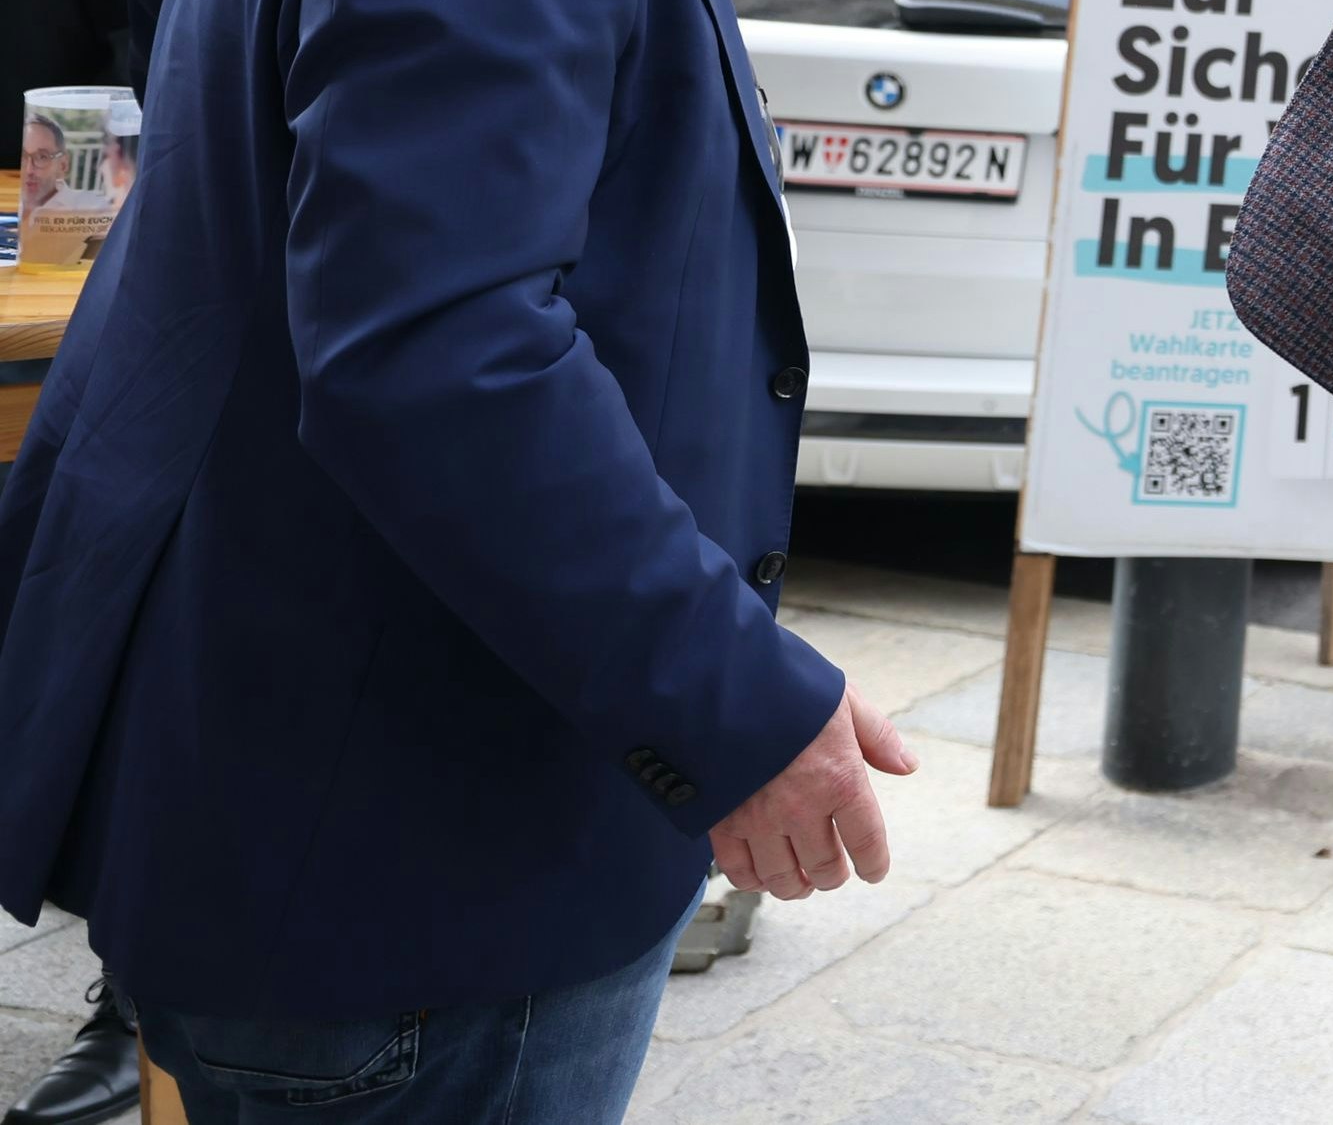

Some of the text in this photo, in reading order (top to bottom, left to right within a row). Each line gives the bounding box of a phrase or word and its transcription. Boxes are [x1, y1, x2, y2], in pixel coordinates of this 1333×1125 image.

[1112, 25, 1315, 104] Sich
[791, 135, 818, 170] W
[1106, 111, 1242, 187] Für
[54, 217, 65, 225] ER
[67, 216, 86, 225] FÜR
[1097, 197, 1175, 271] In
[1129, 334, 1253, 358] Wahlkarte
[1110, 359, 1250, 388] beantragen
[1290, 384, 1310, 442] 1
